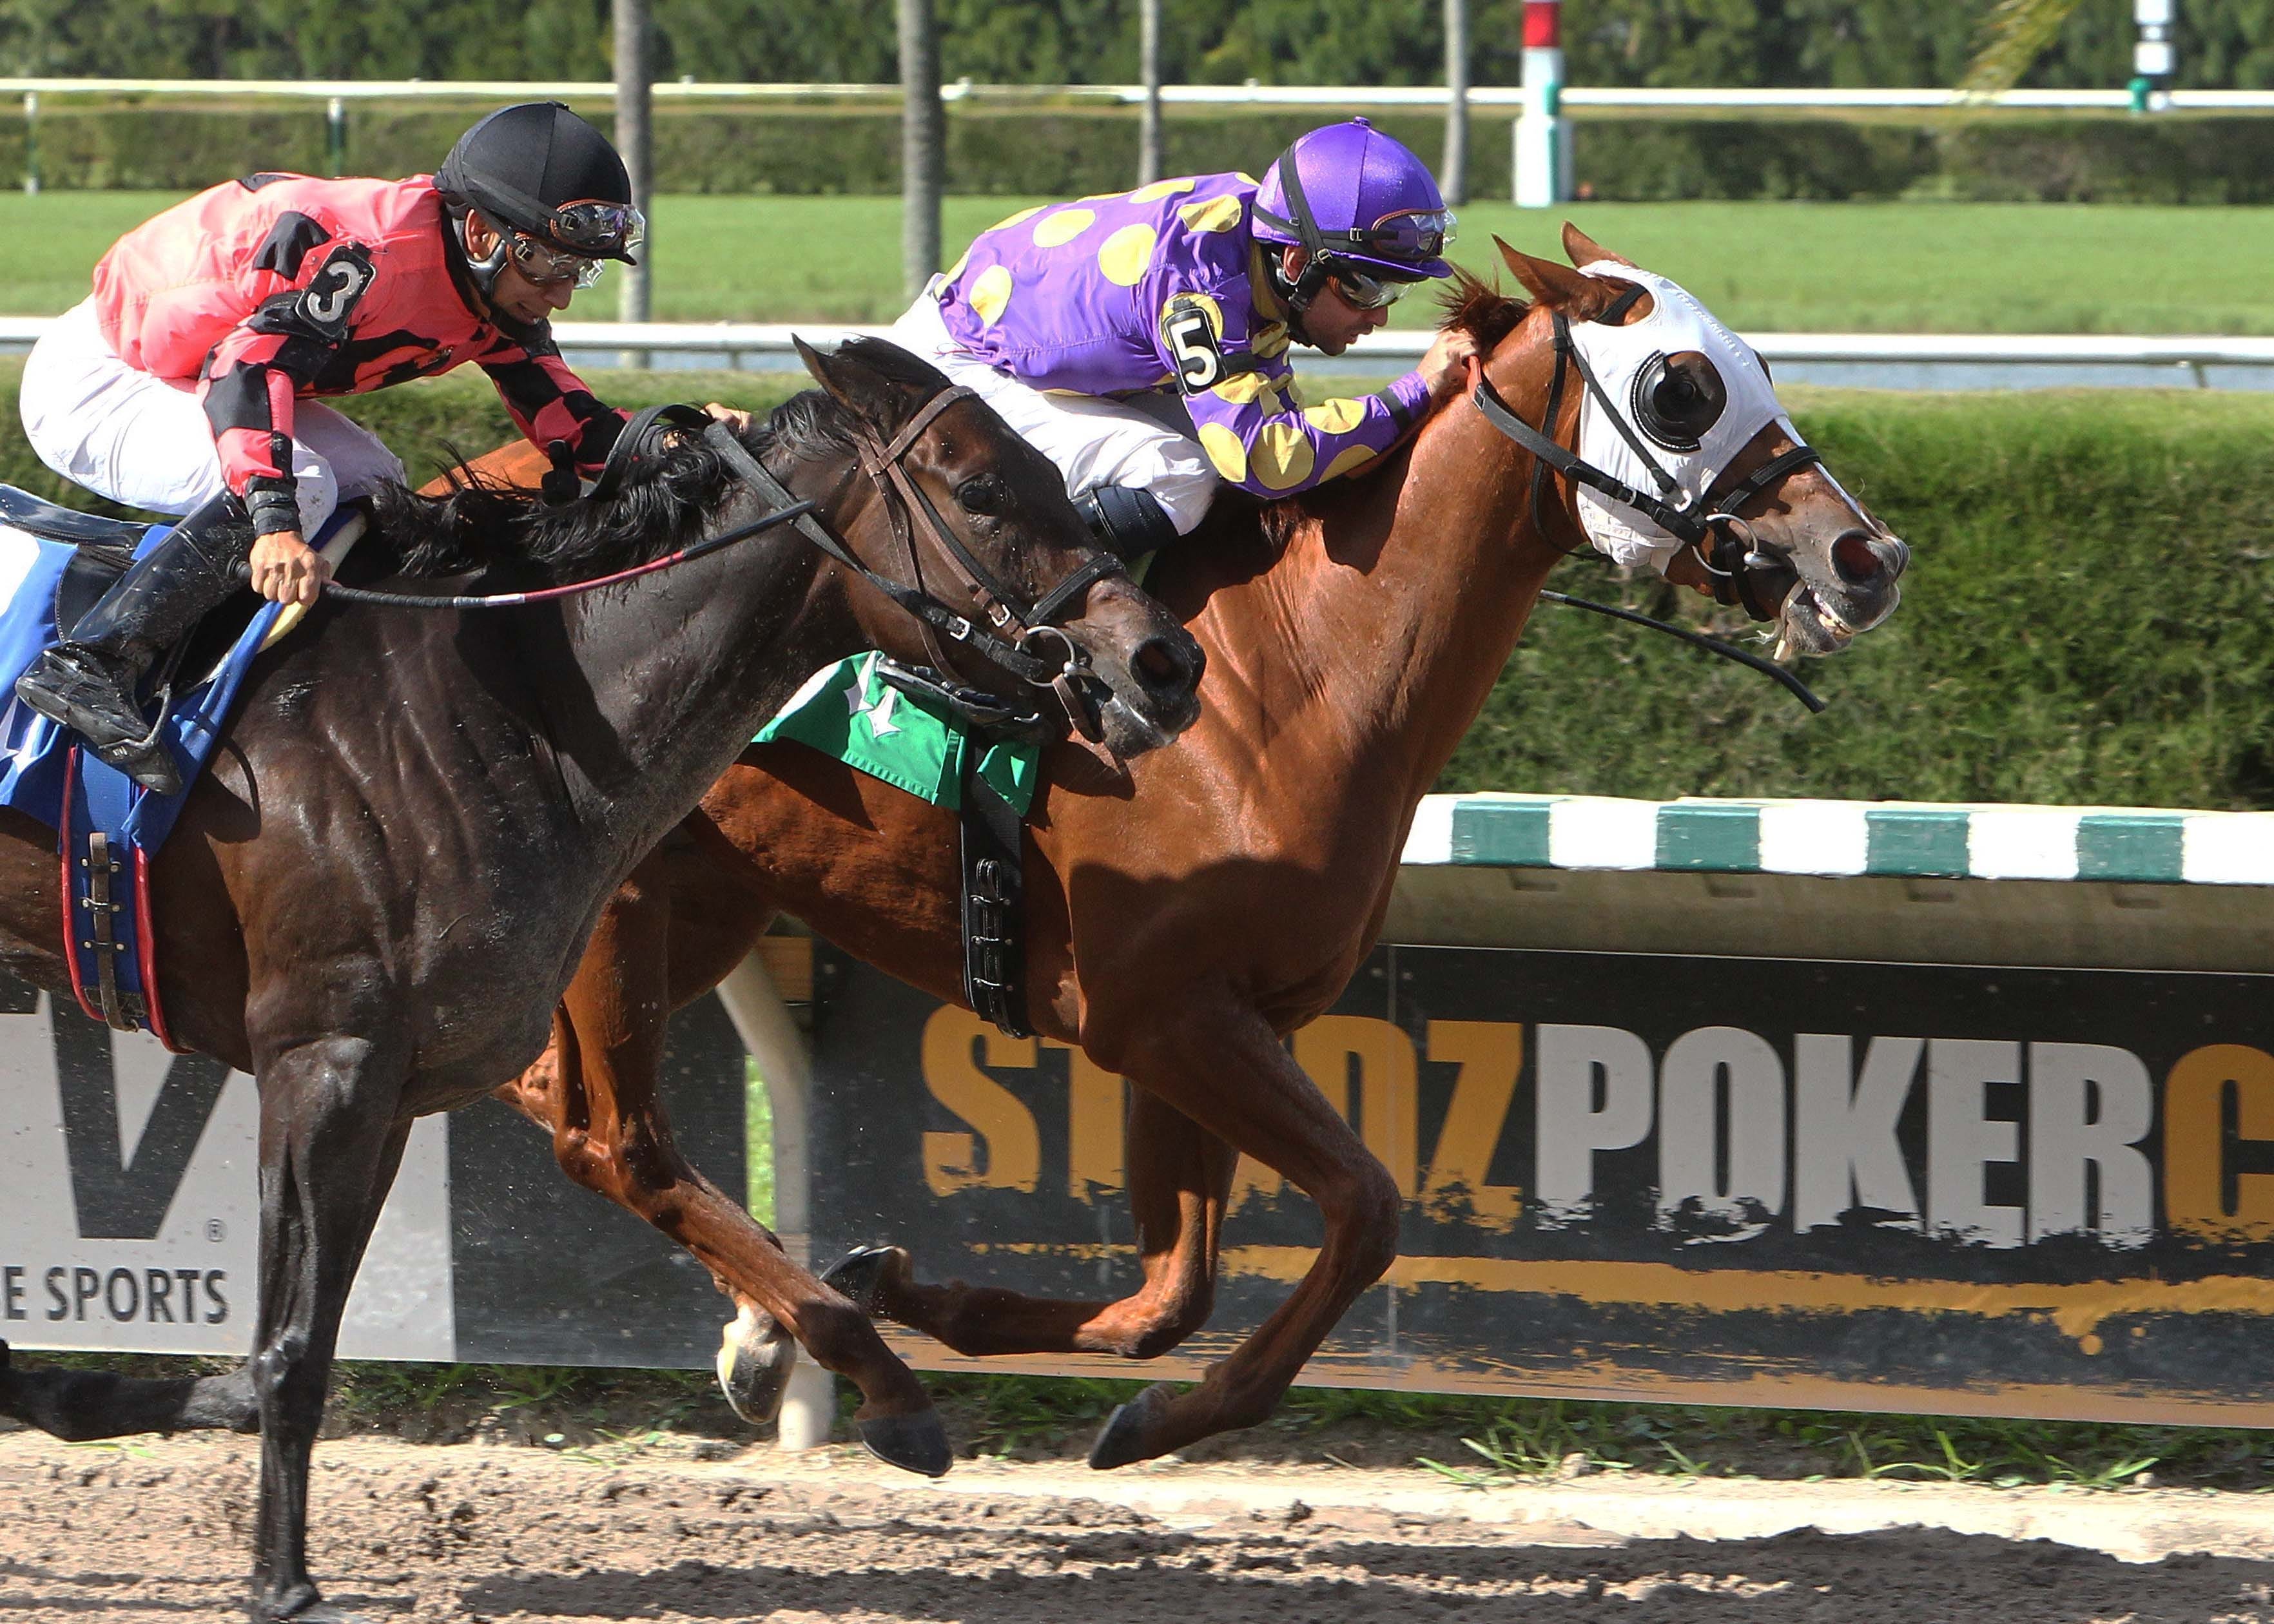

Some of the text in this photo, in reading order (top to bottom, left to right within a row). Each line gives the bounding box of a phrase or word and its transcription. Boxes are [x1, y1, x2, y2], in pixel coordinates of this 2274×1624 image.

[306, 260, 360, 322] 3
[1170, 318, 1217, 385] 5
[46, 1266, 229, 1324] SPORTS
